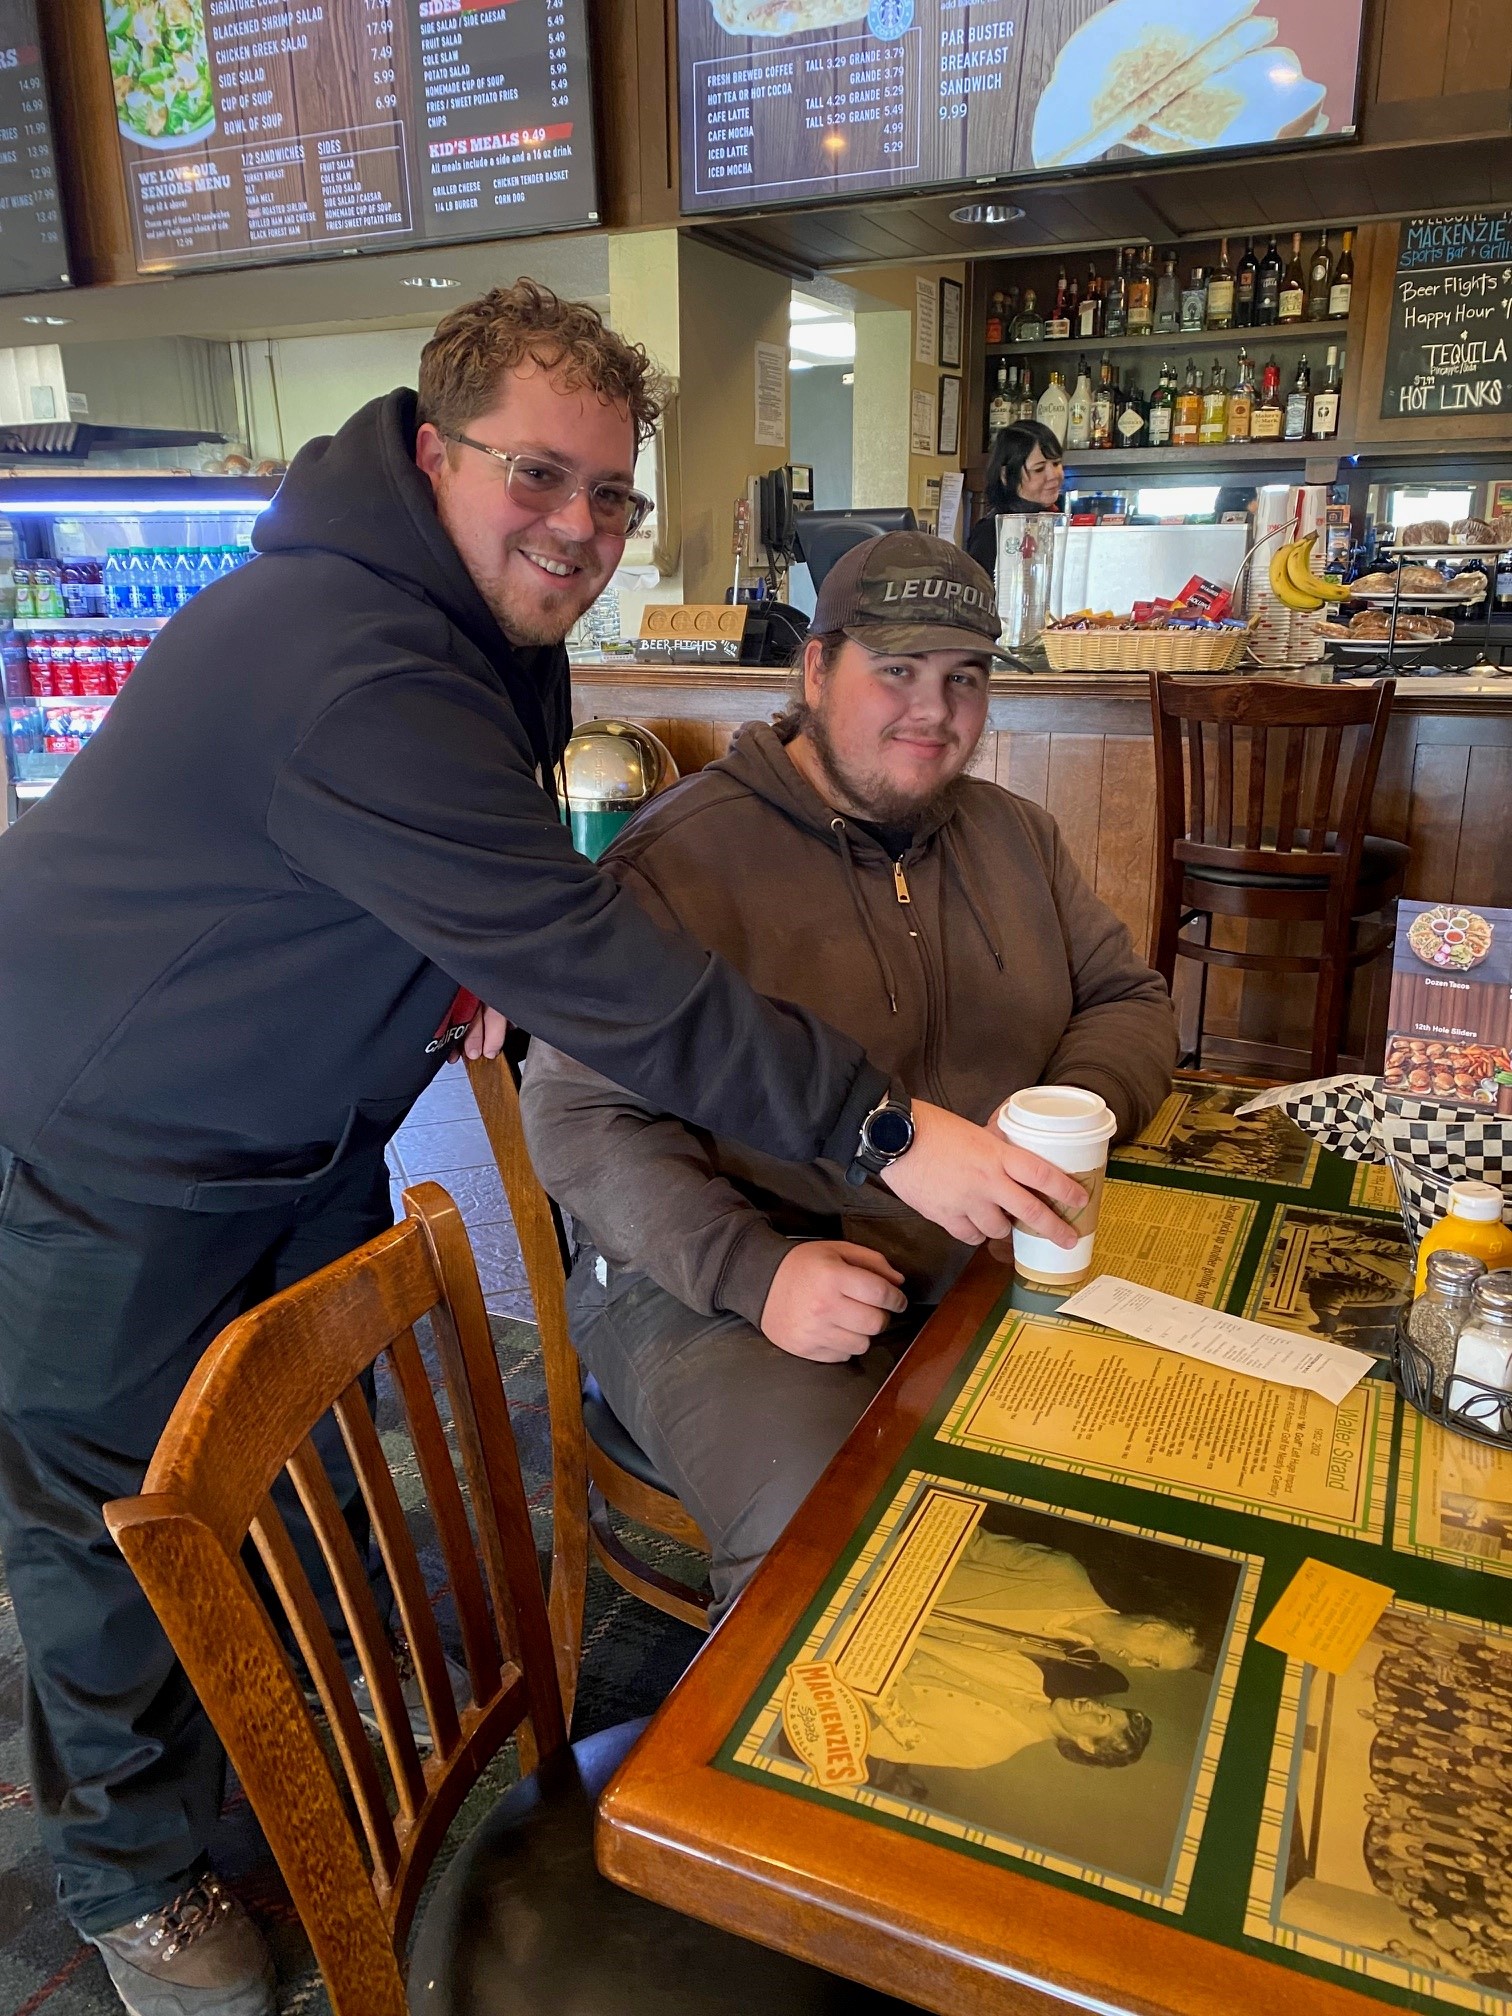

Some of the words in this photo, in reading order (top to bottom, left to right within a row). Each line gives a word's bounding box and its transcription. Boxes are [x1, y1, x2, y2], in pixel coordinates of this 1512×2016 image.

[419, 0, 461, 17] SIDES
[213, 19, 259, 40] BLACKENED
[262, 12, 293, 31] SHRIMP
[296, 6, 322, 24] SALAD
[367, 19, 393, 36] 17.99
[420, 22, 436, 35] SIDE
[437, 18, 457, 31] SALAD
[464, 14, 479, 27] SIDE
[480, 9, 506, 24] CAESAR
[548, 14, 564, 27] 5.49
[422, 36, 440, 50] FRUIT
[442, 33, 462, 46] SALAD
[548, 31, 565, 44] 5.49
[942, 29, 964, 47] PAR
[968, 21, 1014, 42] BUSTER
[216, 46, 250, 65] CHICKEN
[252, 40, 279, 57] GREEK
[281, 35, 307, 52] SALAD
[371, 46, 392, 61] 7.49
[423, 54, 439, 66] COLE
[441, 51, 459, 63] SLAW
[549, 48, 566, 60] 5.49
[941, 47, 1008, 72] BREAKFAST
[374, 69, 394, 84] 5.99
[424, 69, 447, 81] POTATO
[449, 64, 470, 77] SALAD
[550, 63, 566, 74] 5.99
[708, 73, 730, 87] FRESH
[733, 68, 762, 83] BREWED
[766, 63, 793, 78] COFFEE
[806, 59, 823, 72] TALL
[827, 57, 846, 69] 3.29
[850, 50, 880, 65] GRANDE
[885, 47, 904, 59] 3.79
[19, 77, 40, 91] 14.99
[219, 73, 237, 88] SIDE
[239, 68, 265, 85] SALAD
[425, 82, 460, 97] HOMEMADE
[462, 80, 474, 91] CUP
[477, 78, 485, 89] OF
[487, 74, 504, 87] SOUP
[551, 79, 567, 90] 5.49
[708, 93, 721, 105] HOT
[723, 91, 737, 103] TEA
[739, 89, 749, 100] OR
[751, 86, 765, 99] HOT
[768, 83, 792, 96] COCOA
[850, 69, 881, 84] GRANDE
[885, 66, 904, 79] 3.79
[940, 73, 1002, 96] SANDWICH
[222, 97, 236, 112] CUP
[240, 94, 249, 108] OF
[252, 91, 272, 106] SOUP
[376, 94, 396, 109] 6.99
[427, 100, 444, 113] FRIES
[451, 96, 471, 109] SWEET
[474, 92, 497, 105] POTATO
[499, 89, 518, 101] FRIES
[552, 95, 568, 107] 3.49
[708, 111, 726, 123] CAFE
[728, 107, 749, 121] LATTE
[806, 97, 823, 109] TALL
[827, 94, 846, 107] 4.29
[849, 89, 880, 103] GRANDE
[885, 85, 904, 97] 5.29
[940, 103, 967, 119] 9.99
[25, 122, 46, 135] 11.99
[224, 119, 247, 135] BOWL
[249, 117, 259, 131] OF
[262, 113, 282, 129] SOUP
[428, 115, 447, 129] CHIPS
[708, 130, 726, 142] CAFE
[729, 126, 754, 139] MOCHA
[806, 116, 823, 129] TALL
[827, 113, 846, 124] 5.29
[849, 108, 880, 123] GRANDE
[885, 104, 903, 116] 5.49
[318, 139, 341, 155] SIDES
[429, 140, 467, 158] KID'S
[470, 132, 519, 152] MEALS
[522, 128, 545, 144] 9.49
[709, 148, 724, 160] ICED
[727, 145, 748, 158] LATTE
[884, 122, 903, 134] 4.99
[256, 145, 305, 164] SANDWICHES
[553, 145, 572, 157] drink
[709, 166, 724, 178] ICED
[727, 163, 752, 176] MOCHA
[884, 141, 903, 153] 5.29
[139, 172, 158, 186] WE
[193, 163, 217, 177] OUR
[494, 176, 519, 189] CHICKEN
[521, 173, 544, 185] TENDER
[545, 170, 568, 182] BASKET
[141, 182, 194, 199] SENIORS
[195, 175, 230, 192] MENU
[433, 185, 457, 196] GRILLED
[458, 181, 481, 193] CHEESE
[455, 198, 478, 210] BURGER
[495, 194, 511, 205] CORN
[1400, 248, 1443, 266] Sports
[1447, 246, 1468, 262] Bar
[1399, 282, 1440, 302] Beer
[1445, 273, 1497, 297] Flights
[1405, 307, 1451, 329] Happy
[1456, 304, 1495, 323] Hour
[1422, 338, 1507, 369] TEQUILA
[1400, 385, 1435, 411] HOT
[1440, 379, 1502, 409] LINKS
[640, 639, 672, 655] BEER
[671, 640, 717, 655] FLIGHTS
[1425, 978, 1449, 988] Dozen
[1449, 980, 1470, 990] Tacos
[1415, 1023, 1431, 1032] 12th
[1433, 1025, 1450, 1034] Hole
[1451, 1027, 1477, 1038] Sliders
[1224, 1204, 1241, 1221] Strand
[1219, 1221, 1235, 1235] picks
[1214, 1236, 1225, 1244] up
[1207, 1245, 1223, 1267] another
[1196, 1267, 1217, 1289] golfing
[1335, 1409, 1359, 1446] Walter
[1280, 1433, 1290, 1444] Golf
[1291, 1448, 1301, 1458] Left
[1287, 1459, 1299, 1473] Huge
[1329, 1448, 1354, 1491] Strand
[1267, 1475, 1281, 1498] Century
[1284, 1474, 1296, 1493] Impact
[790, 1691, 799, 1709] BAR
[796, 1667, 857, 1780] MACKENZIE'S
[838, 1688, 859, 1721] HAGGIN
[853, 1723, 861, 1748] OAKS
[791, 1724, 814, 1759] GRILLE
